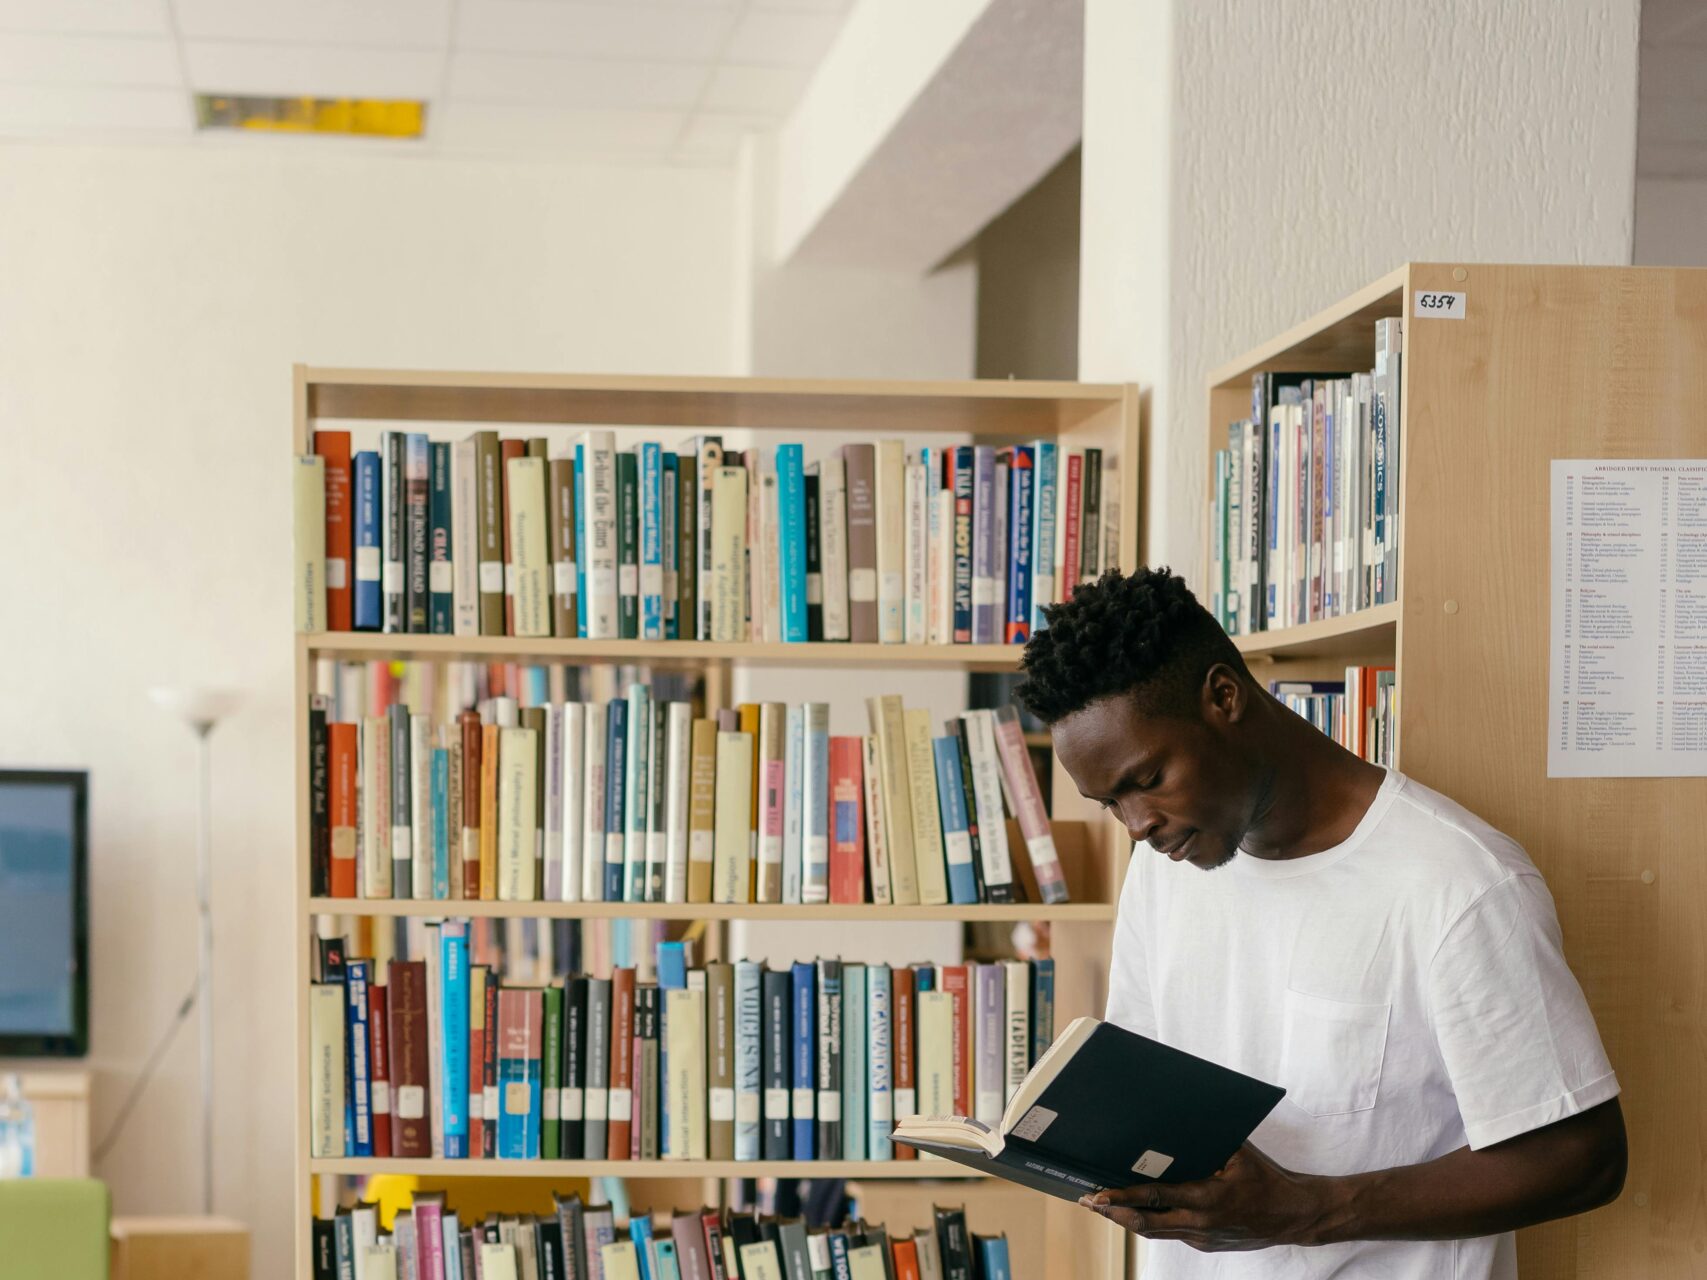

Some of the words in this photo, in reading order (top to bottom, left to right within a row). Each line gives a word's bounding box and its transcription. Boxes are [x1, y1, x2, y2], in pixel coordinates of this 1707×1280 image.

[1376, 391, 1386, 492] ECONOMICS
[593, 450, 609, 493] Behind
[645, 469, 657, 510] Reporting
[593, 496, 609, 516] the
[646, 512, 657, 528] and
[955, 515, 971, 557] NOT
[304, 561, 315, 632] Generalities
[742, 986, 761, 1056] VOICES
[872, 988, 889, 1092] ORGANIZATIONS
[321, 1045, 331, 1094] sciences
[321, 1099, 331, 1131] social
[680, 1070, 690, 1123] interaction
[321, 1135, 332, 1154] The
[680, 1127, 690, 1158] Social
